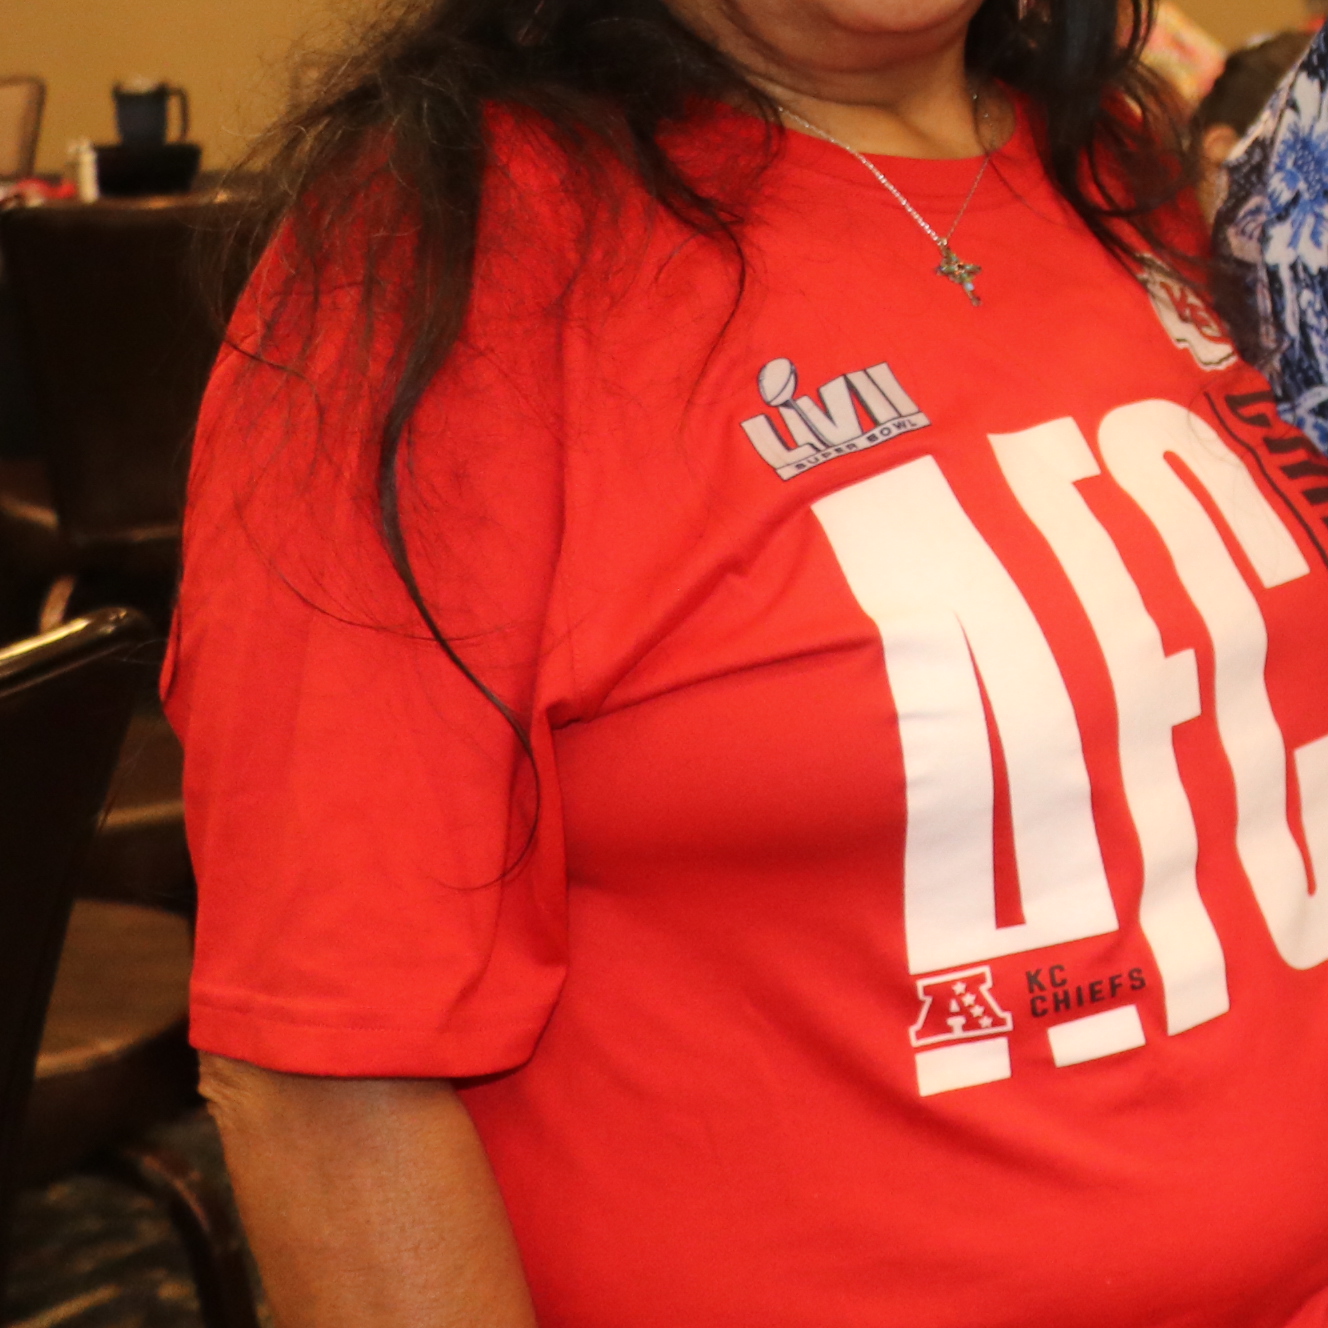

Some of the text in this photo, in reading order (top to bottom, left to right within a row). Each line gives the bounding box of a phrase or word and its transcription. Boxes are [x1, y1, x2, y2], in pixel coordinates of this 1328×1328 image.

[740, 361, 921, 470] LVII
[794, 418, 919, 471] SUPER BOWL
[1025, 964, 1068, 993] KC
[1030, 968, 1147, 1018] CHIEFS
